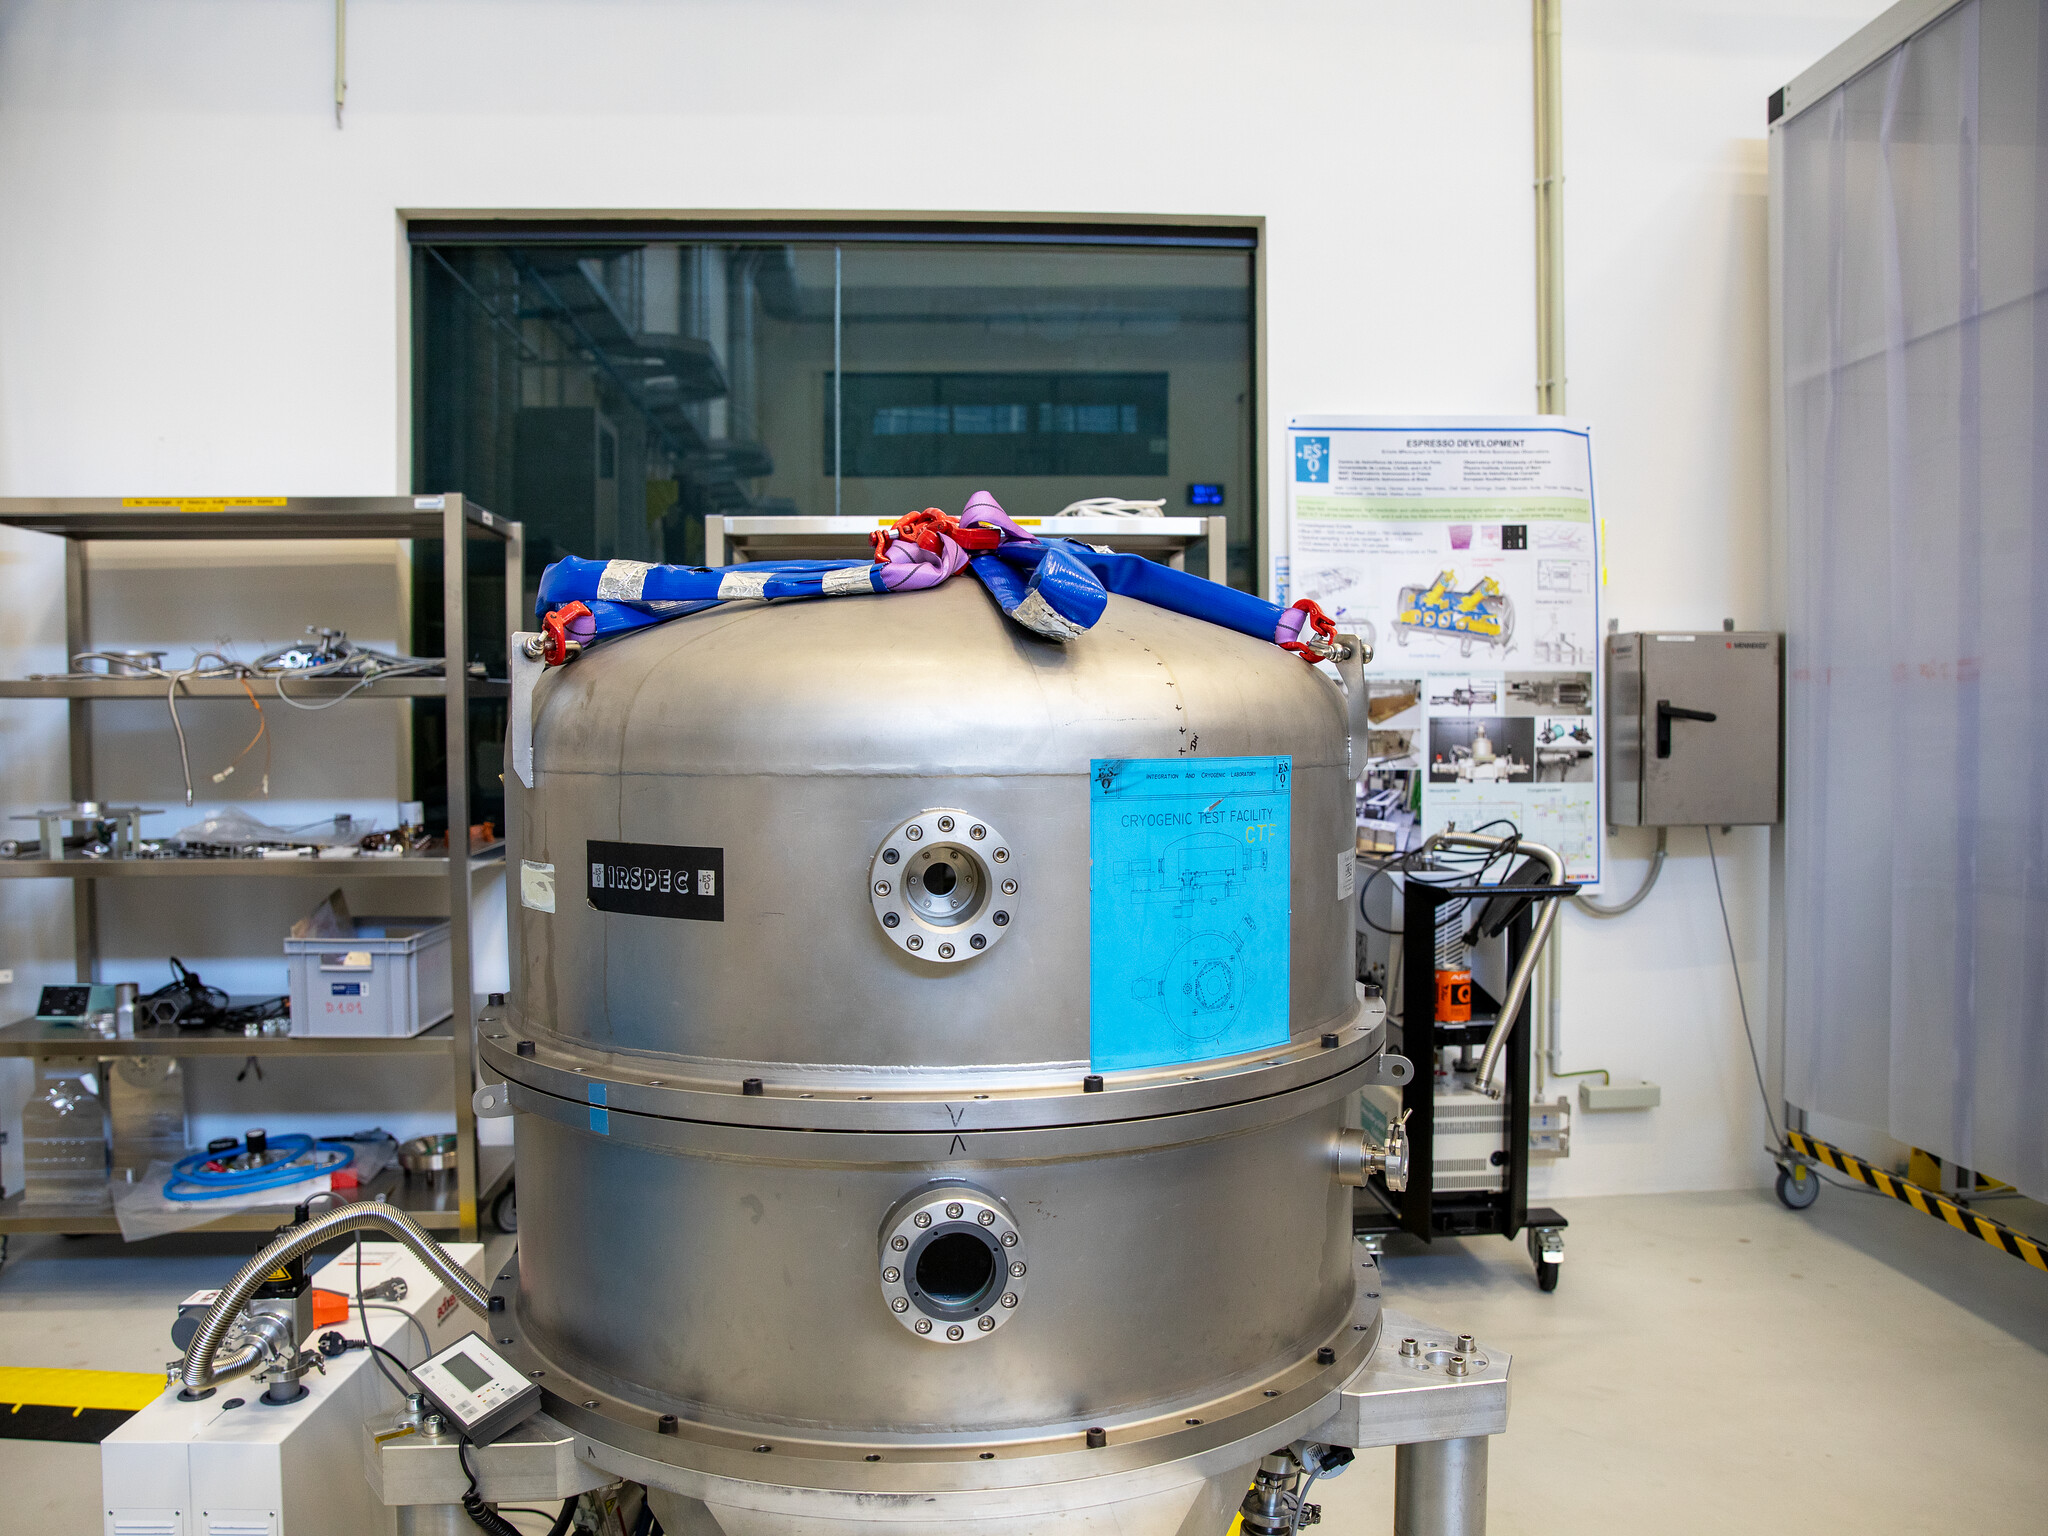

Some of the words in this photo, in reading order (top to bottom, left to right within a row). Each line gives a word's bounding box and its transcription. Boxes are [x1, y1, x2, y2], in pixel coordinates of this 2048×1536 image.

[1406, 439, 1455, 448] ESPRESSO
[1457, 439, 1525, 448] DEVELOPMENT
[1121, 812, 1193, 828] CRYOGENIC
[1198, 810, 1226, 824] TEST
[1230, 808, 1273, 823] FACILITY
[1245, 823, 1277, 844] CTF
[608, 865, 689, 894] IRSPEC
